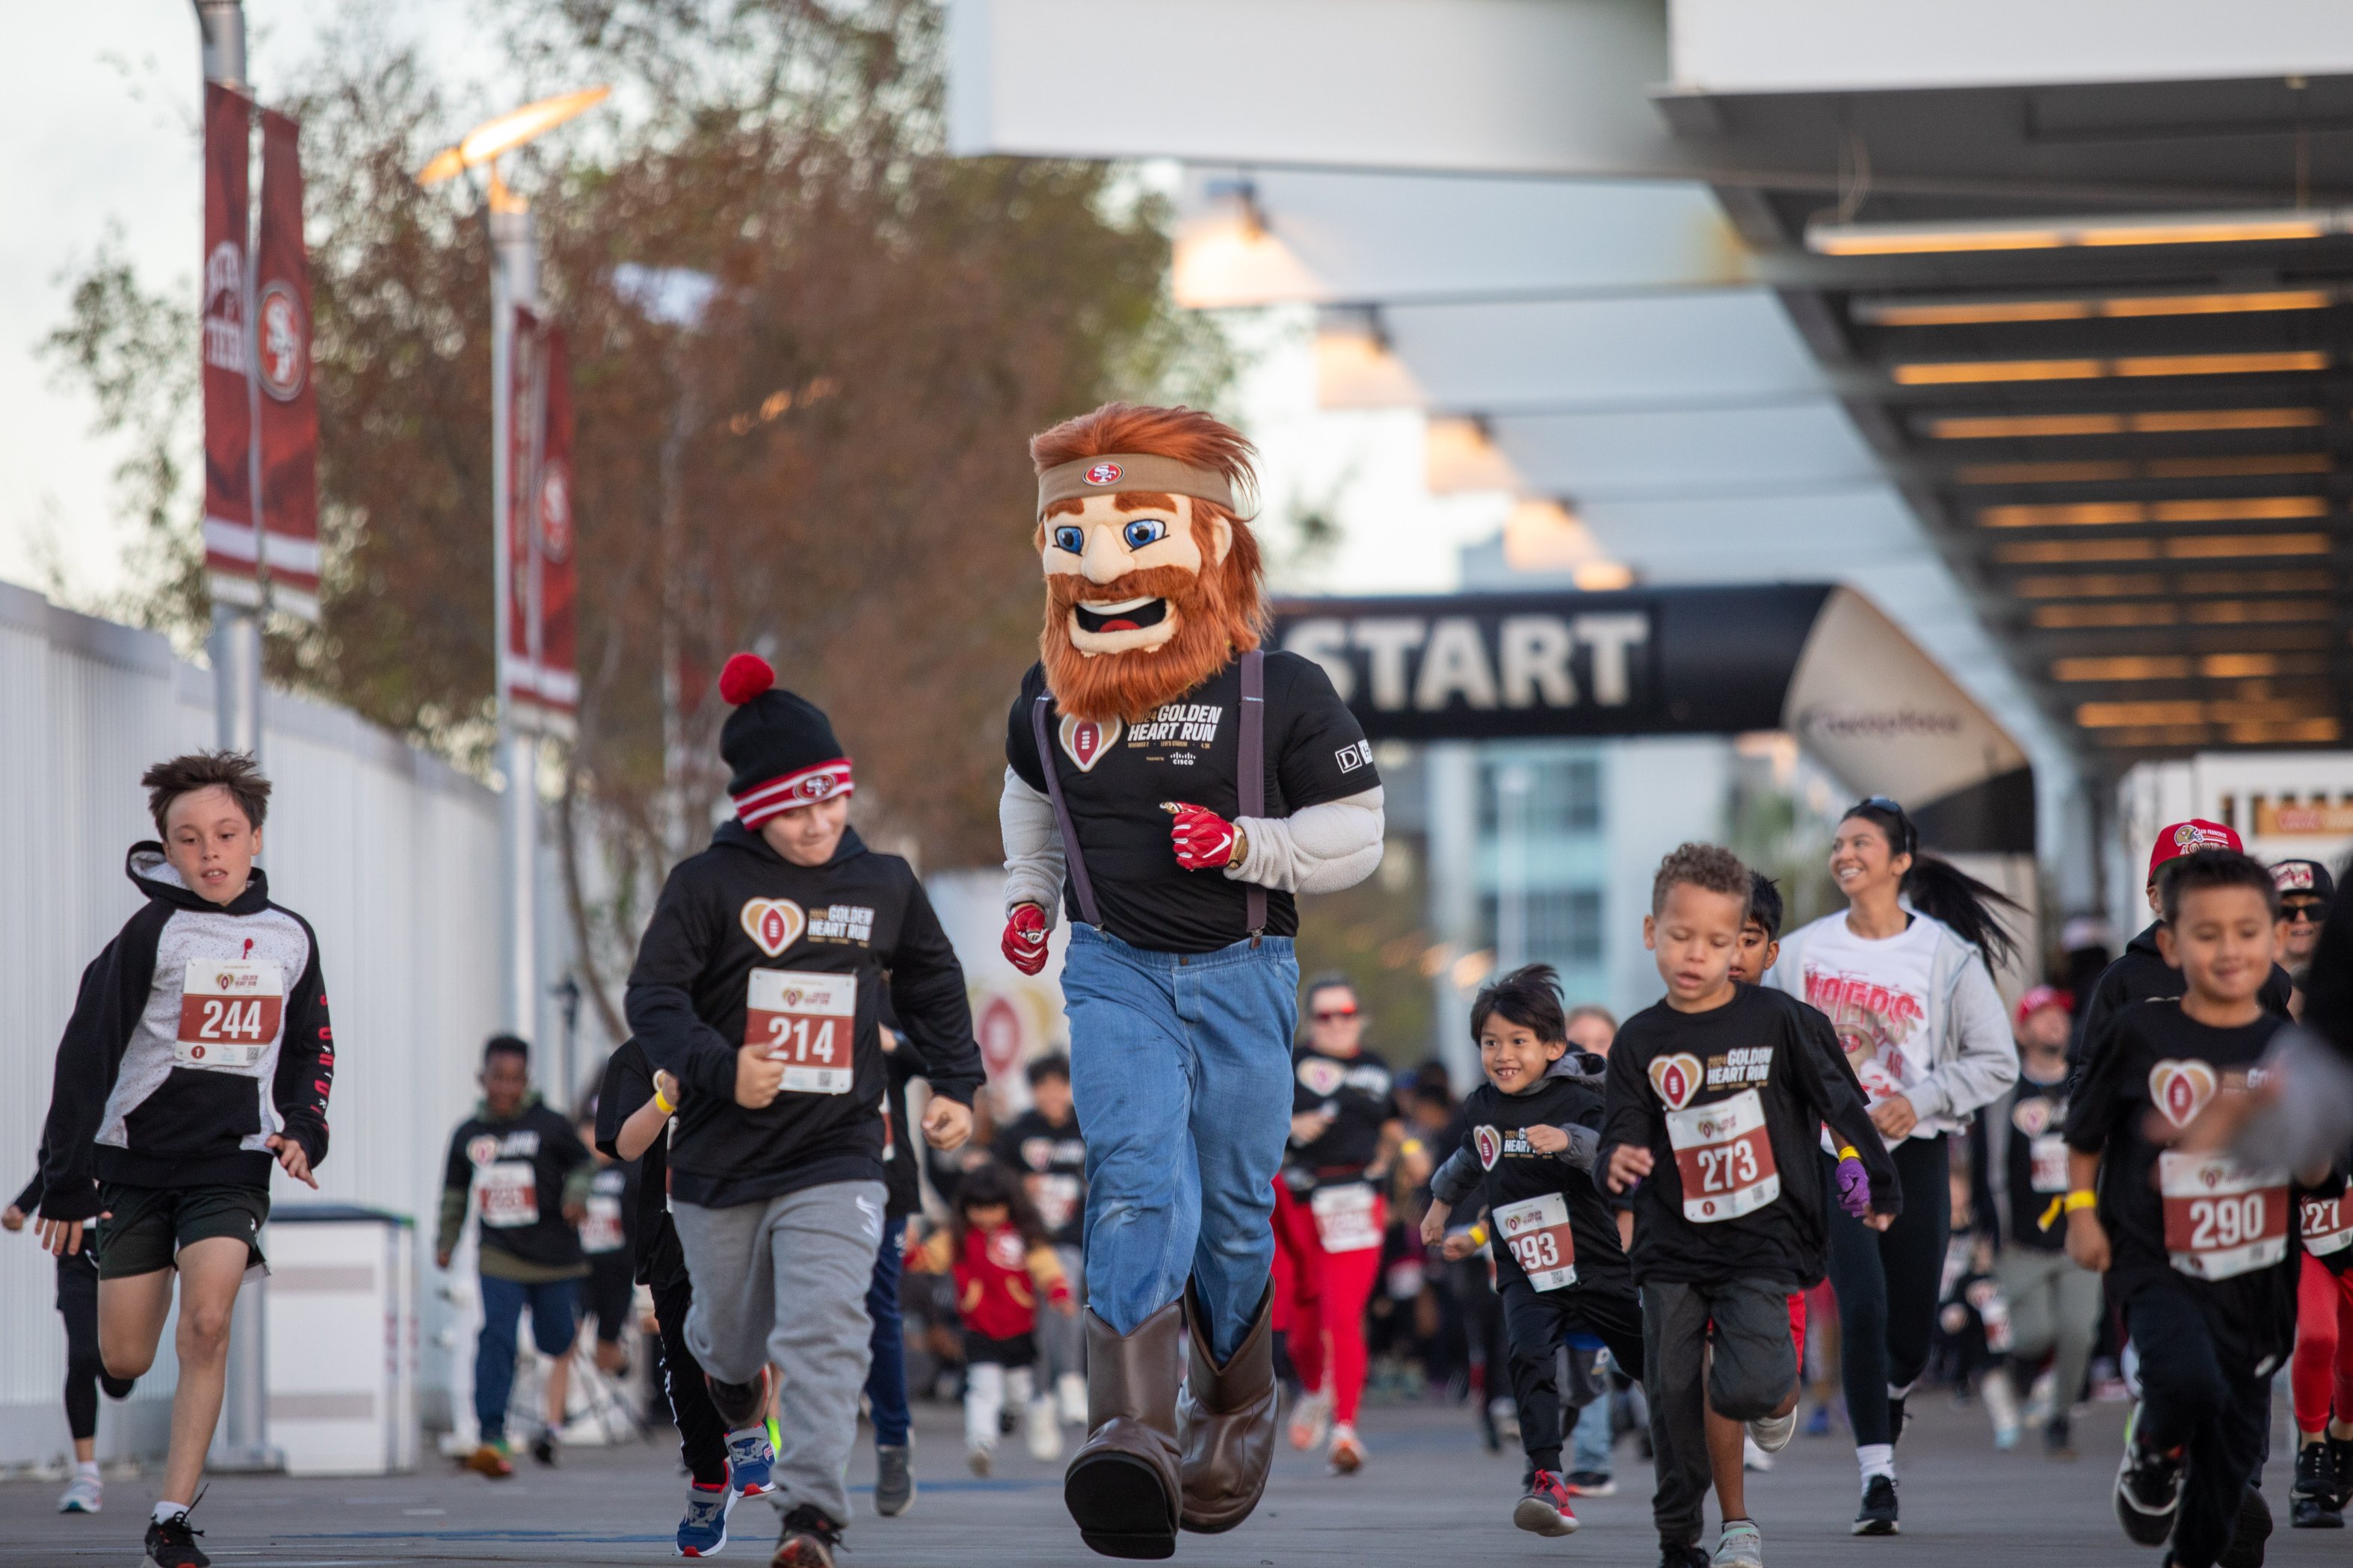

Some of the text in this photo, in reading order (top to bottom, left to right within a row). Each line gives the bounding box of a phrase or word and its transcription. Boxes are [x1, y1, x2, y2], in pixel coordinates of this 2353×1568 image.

[1283, 613, 1650, 712] START
[1137, 704, 1222, 724] 024 GOLDEN
[1127, 723, 1217, 742] HEART RUN
[807, 919, 872, 942] HEART RUN
[828, 905, 875, 926] GOLDEN
[199, 999, 262, 1040] 244
[765, 1016, 835, 1064] 214
[1727, 1046, 1774, 1067] GOLDEN
[1706, 1064, 1770, 1085] HEART RUN
[1697, 1139, 1759, 1193] 273
[2189, 1193, 2265, 1250] 290
[1508, 1232, 1559, 1269] 293
